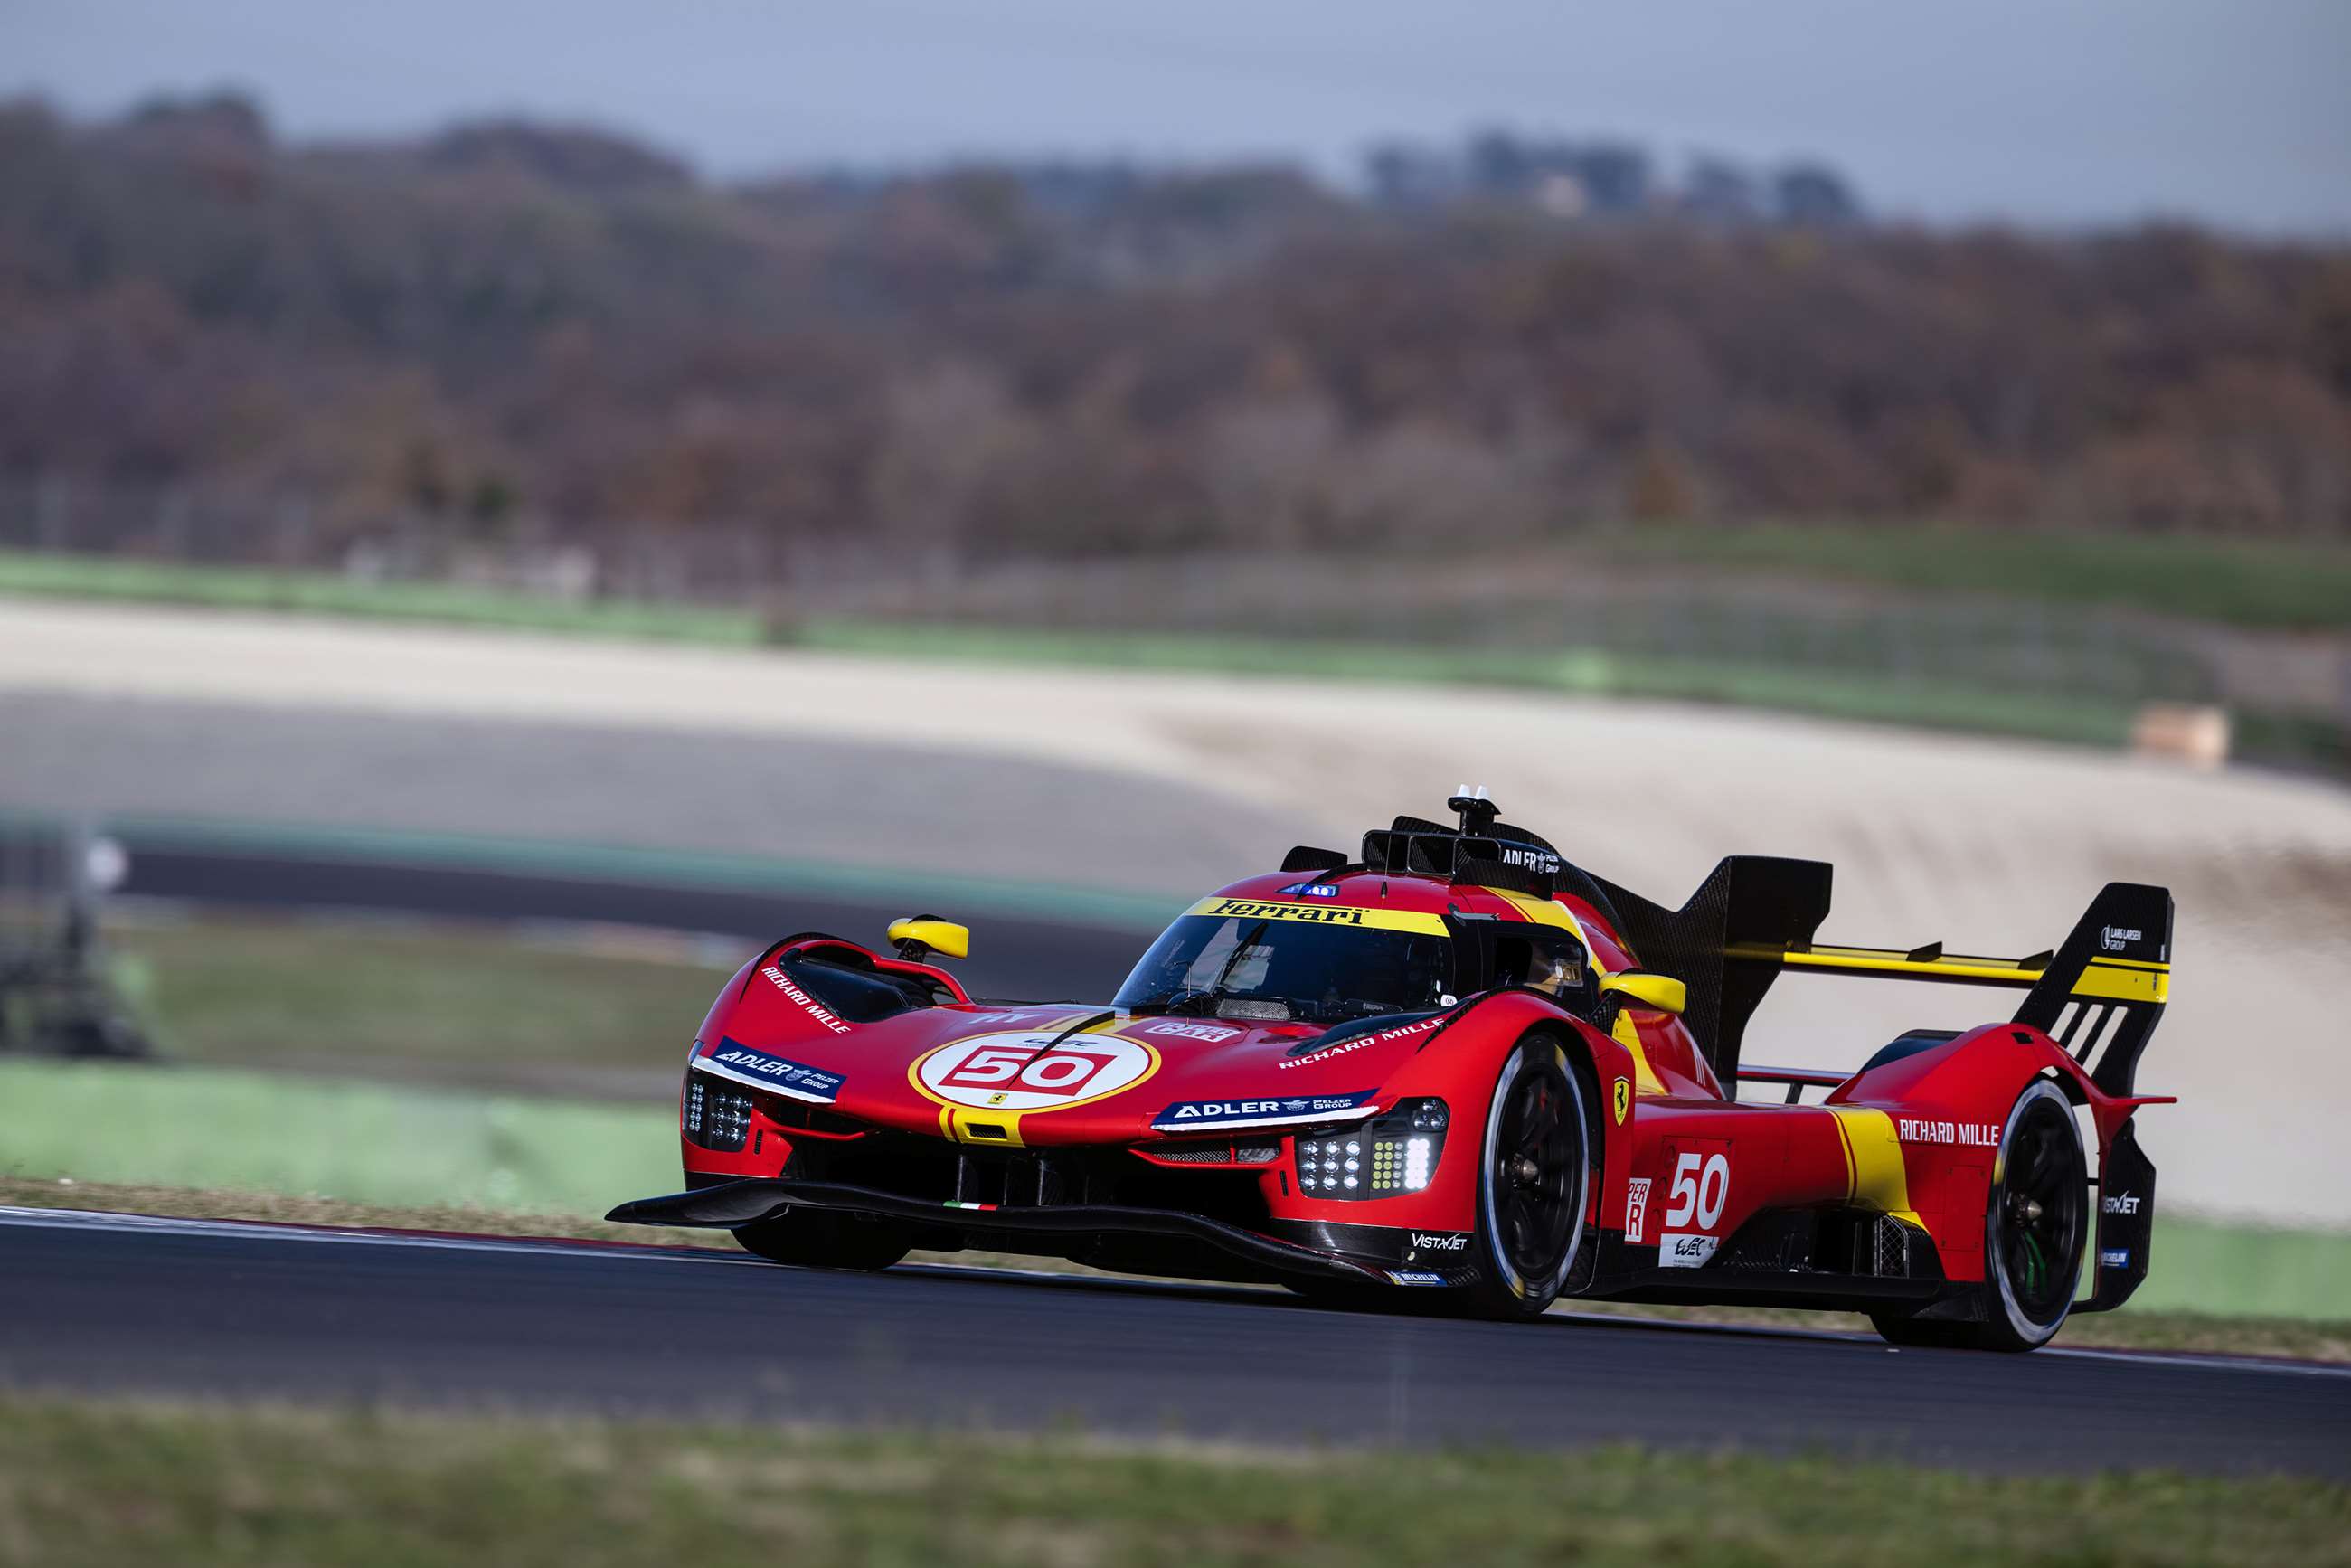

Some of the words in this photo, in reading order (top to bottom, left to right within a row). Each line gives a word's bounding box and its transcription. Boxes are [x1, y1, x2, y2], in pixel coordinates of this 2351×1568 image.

[1208, 899, 1364, 925] Ferrari
[761, 966, 811, 1006] RICHARD
[805, 1004, 852, 1034] MILLE
[1279, 1036, 1375, 1070] RICHARD
[1382, 1017, 1445, 1041] MILLE
[715, 1051, 794, 1076] ADLER
[951, 1050, 1095, 1089] 50
[800, 1078, 829, 1090] GROUP
[810, 1072, 839, 1084] PELZER
[1174, 1100, 1279, 1119] ADLER
[1899, 1119, 1954, 1144] RICHARD
[1958, 1123, 1999, 1147] MILLE
[1666, 1152, 1730, 1231] 50
[1675, 1237, 1706, 1257] WEC
[1401, 1272, 1440, 1282] MICHELIN
